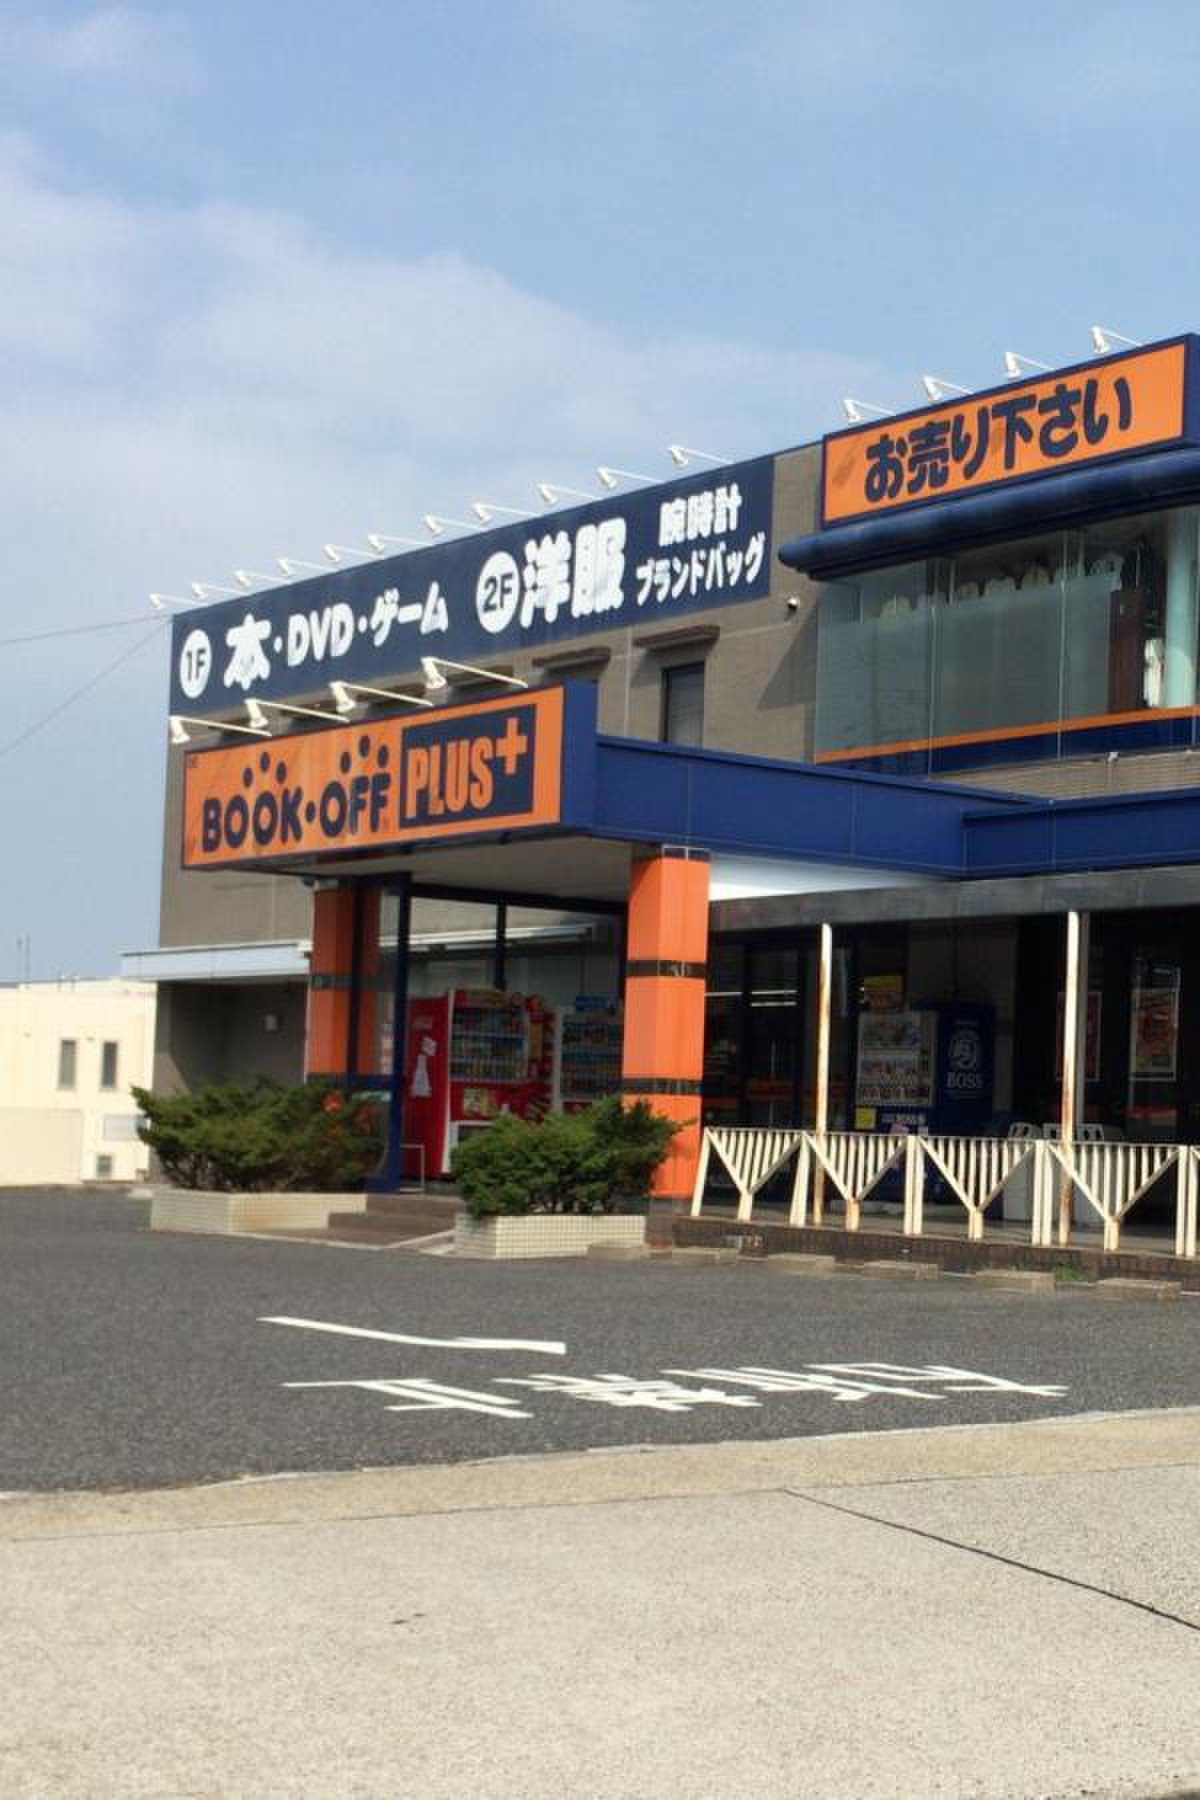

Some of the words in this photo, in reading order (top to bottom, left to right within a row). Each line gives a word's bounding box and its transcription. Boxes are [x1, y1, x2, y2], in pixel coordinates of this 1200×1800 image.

[864, 376, 1133, 502] お売り下さい
[659, 483, 743, 547] 腕時計
[519, 517, 627, 629] 洋服
[635, 531, 766, 608] ブランドバッグ
[945, 1071, 983, 1089] BOSS
